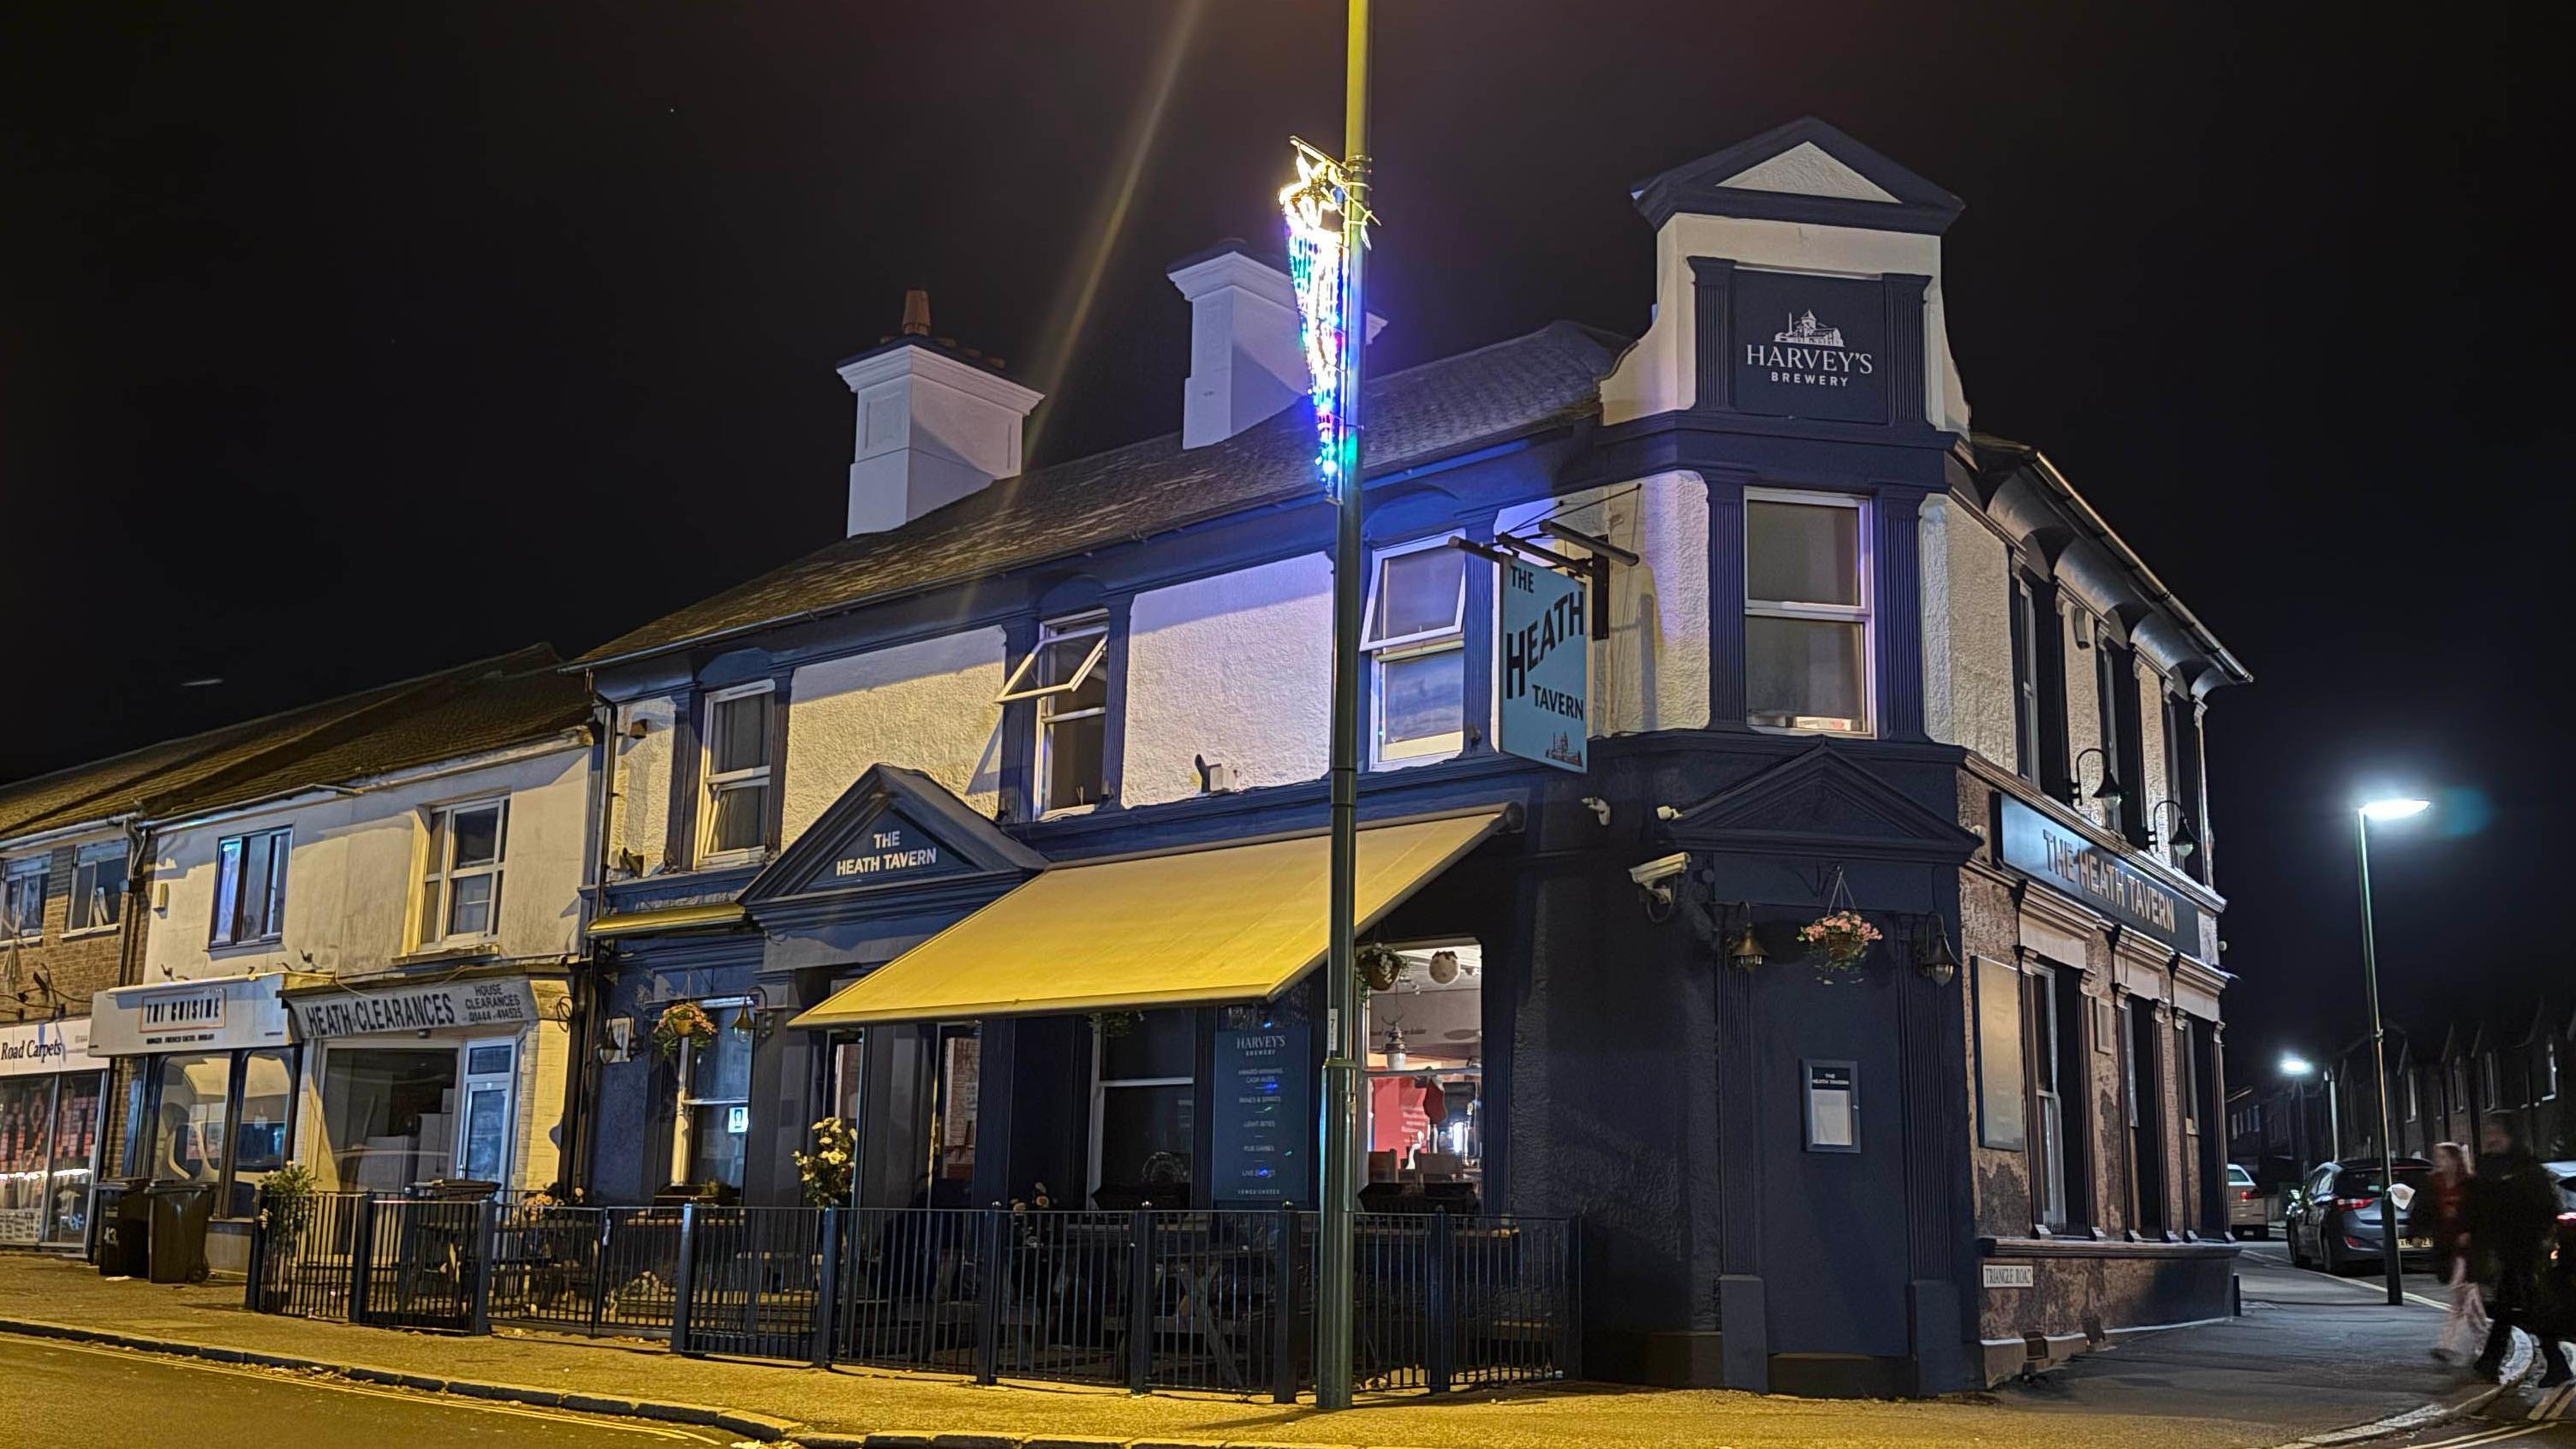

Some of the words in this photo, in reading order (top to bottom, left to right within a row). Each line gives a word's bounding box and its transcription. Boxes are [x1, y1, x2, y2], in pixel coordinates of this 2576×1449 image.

[1746, 344, 1873, 374] HARVEY'S
[1771, 372, 1848, 386] BREWERY
[1510, 565, 1535, 594] THE
[1506, 591, 1584, 700] HEATH
[1531, 683, 1584, 721] TAVERN
[874, 831, 901, 849] THE
[836, 856, 880, 876] HEATH
[883, 848, 937, 870] TAVERN
[2042, 829, 2076, 883] THE
[2077, 849, 2126, 909] HEATH
[2126, 874, 2176, 933] TAVERN
[465, 994, 521, 1010] CLEARANCES
[474, 984, 504, 996] HOUSE
[146, 1003, 164, 1023] TRI
[171, 998, 219, 1022] CUISINE
[305, 1004, 354, 1036] HEATH
[355, 995, 455, 1031] CLEARANCES
[1, 1040, 25, 1060] Road
[27, 1039, 62, 1063] Carpets
